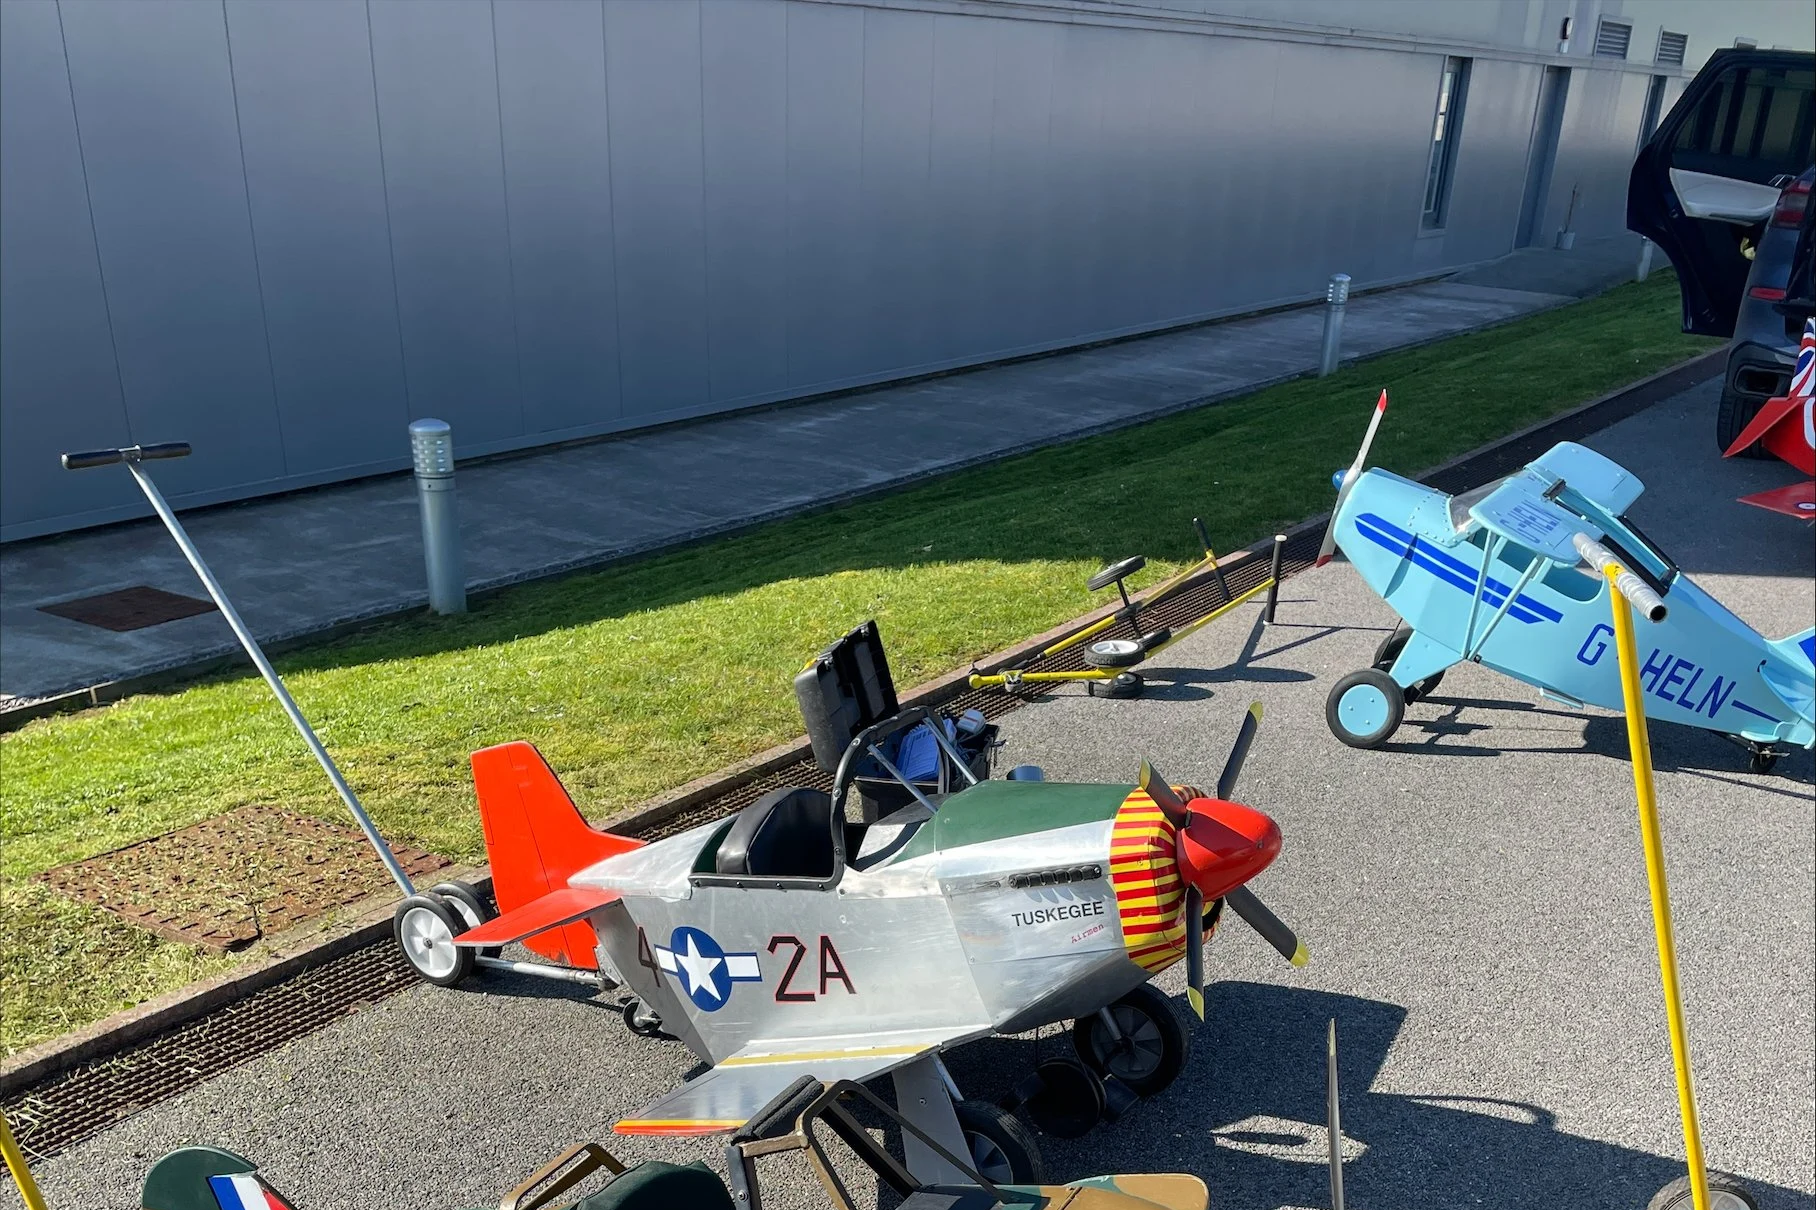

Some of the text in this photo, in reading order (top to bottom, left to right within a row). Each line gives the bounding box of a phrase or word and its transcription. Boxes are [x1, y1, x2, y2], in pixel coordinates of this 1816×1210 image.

[1499, 499, 1562, 544] G-HELN
[1011, 901, 1105, 927] TUSKEGEE
[1070, 923, 1105, 944] Airmen
[637, 926, 858, 1004] 4 2A
